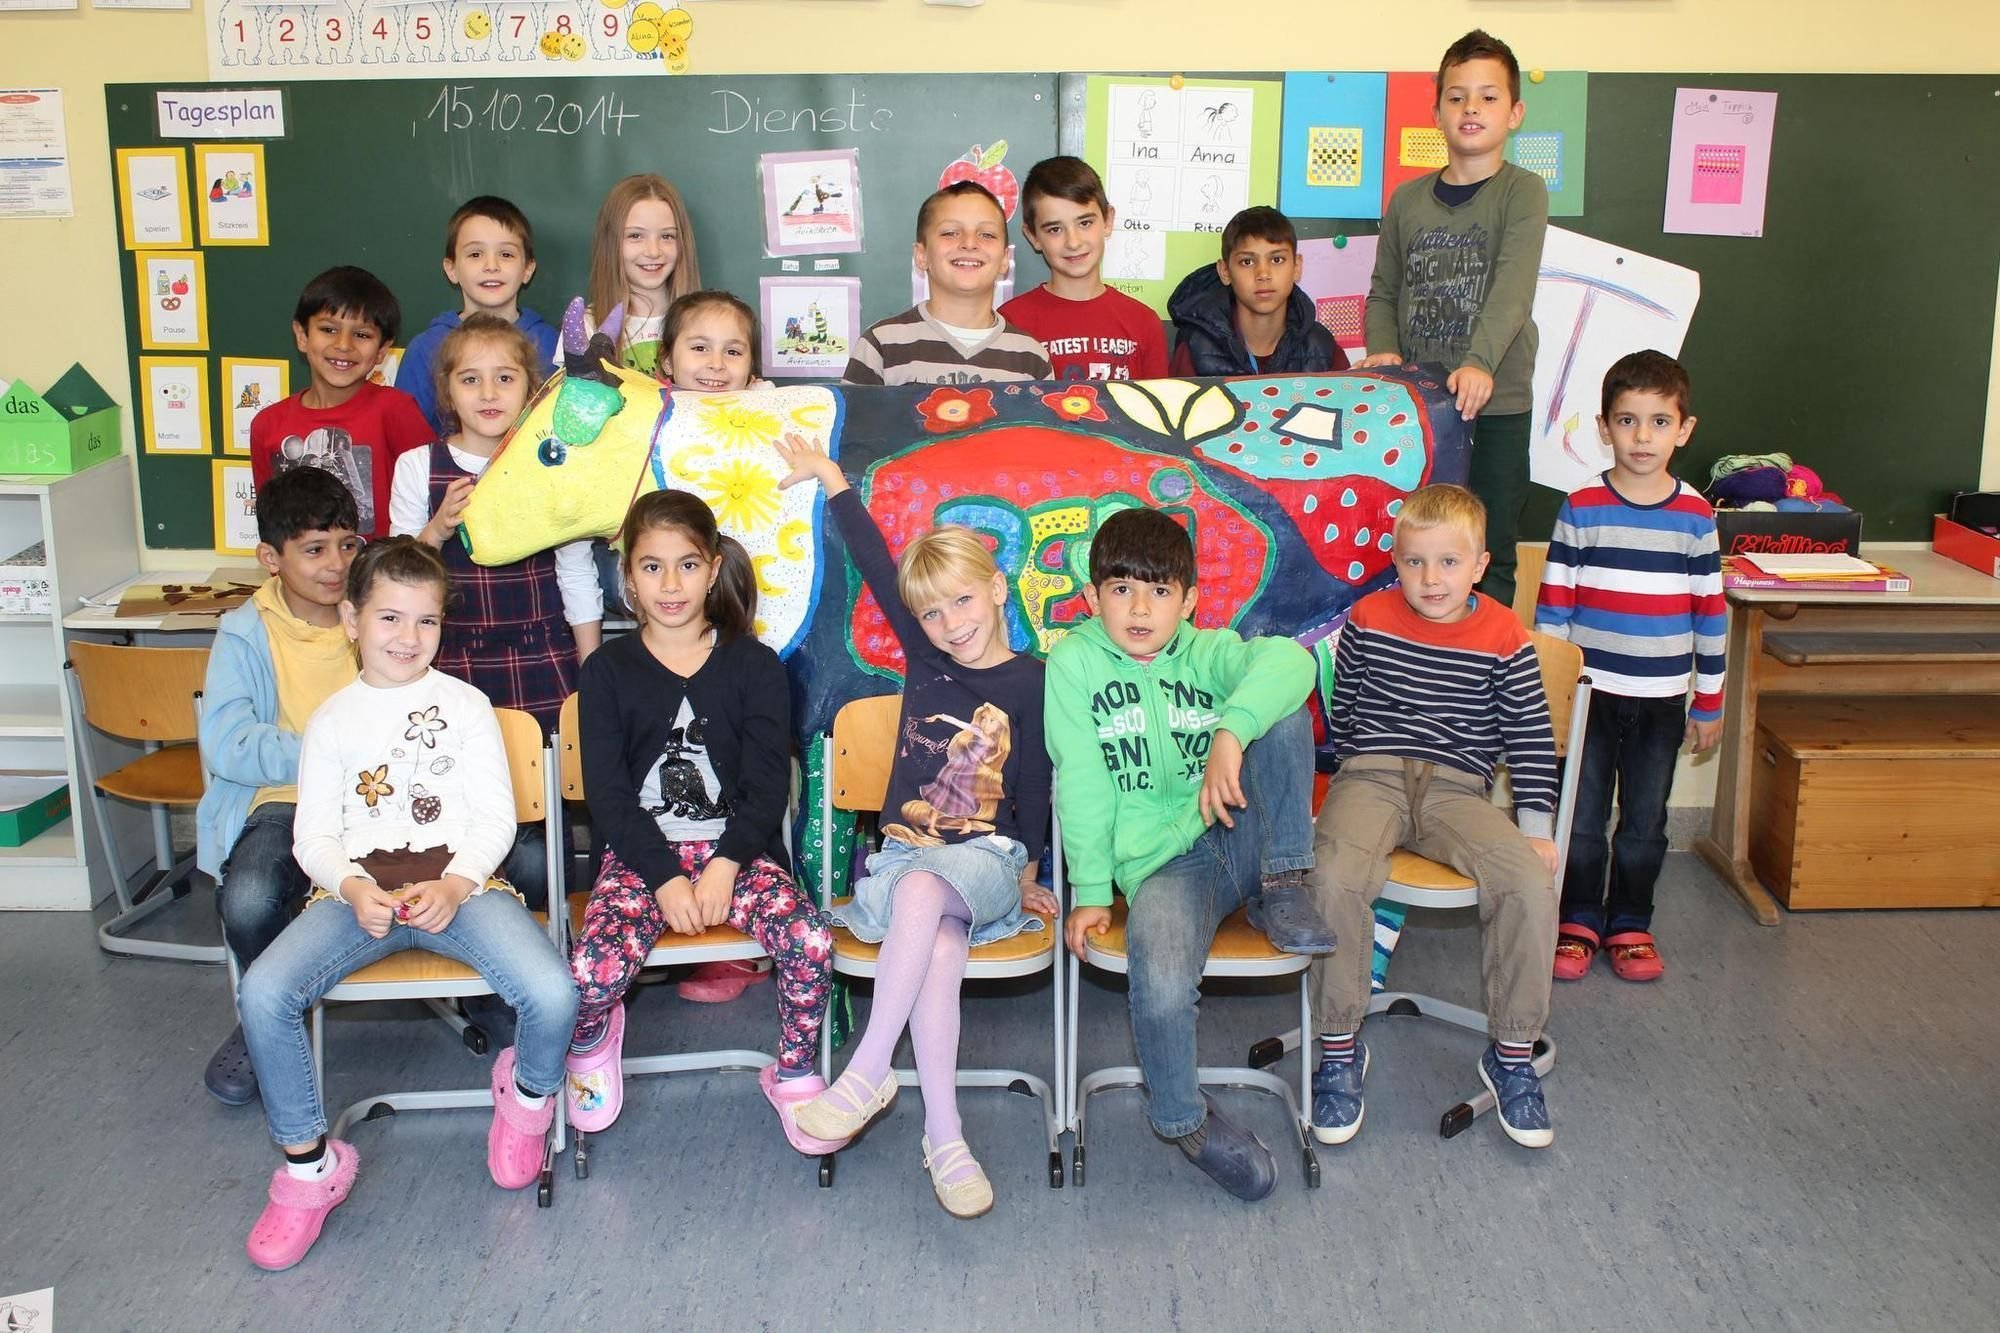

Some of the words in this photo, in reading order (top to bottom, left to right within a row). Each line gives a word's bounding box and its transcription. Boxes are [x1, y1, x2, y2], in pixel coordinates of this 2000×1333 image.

[234, 20, 244, 42] 1
[279, 19, 295, 42] 2
[326, 18, 342, 42] 3
[372, 17, 388, 40] 4
[416, 17, 431, 40] 5
[510, 16, 526, 38] 7
[556, 15, 572, 37] 8
[603, 14, 619, 37] 9
[162, 98, 275, 128] Tagesplan
[1132, 141, 1158, 159] Ina
[1190, 145, 1235, 164] Anna
[144, 224, 171, 234] spielen
[218, 221, 249, 229] Sitzkreis
[1123, 219, 1151, 230] Otto
[1194, 222, 1223, 233] Rita
[163, 326, 186, 334] Pause
[6, 396, 40, 415] das
[87, 432, 102, 452] das
[158, 432, 180, 440] Mathe
[1733, 576, 1775, 588] Happiness
